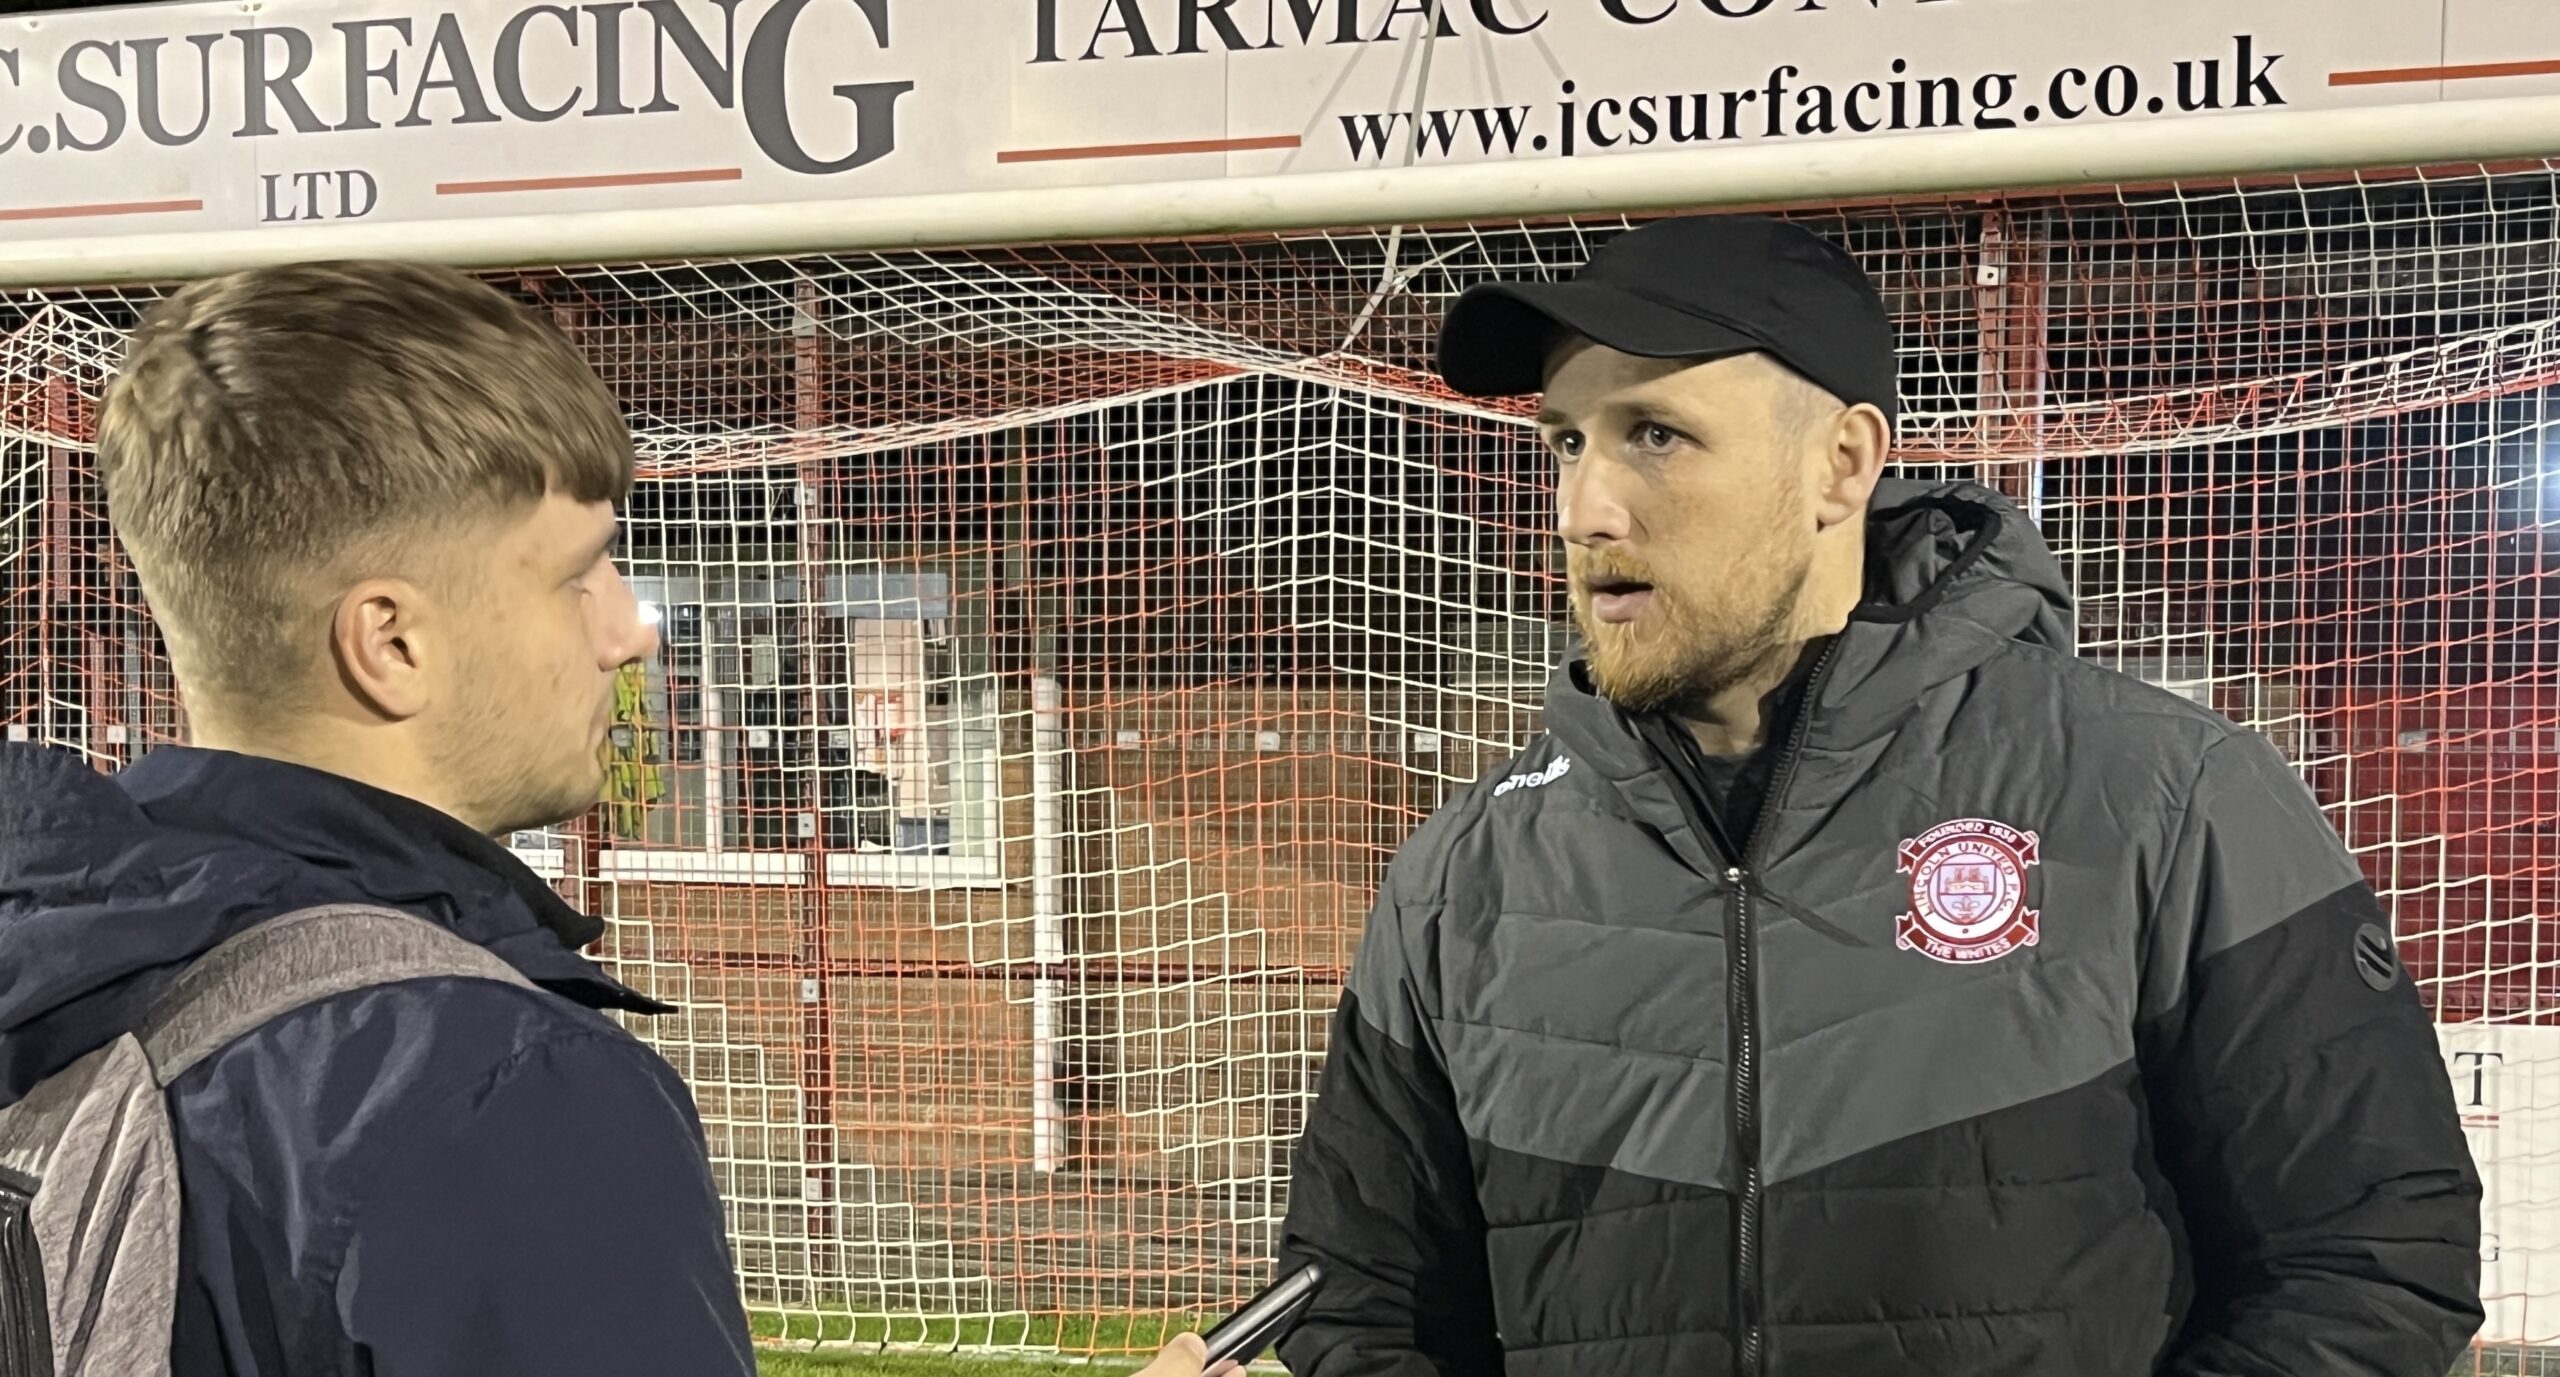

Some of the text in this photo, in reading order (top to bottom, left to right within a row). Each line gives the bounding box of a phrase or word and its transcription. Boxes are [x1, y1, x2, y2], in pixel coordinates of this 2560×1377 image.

[1337, 35, 2287, 161] www.jcsurfacing.co.uk
[260, 169, 379, 223] LTD
[1957, 842, 2015, 875] UNITED
[1925, 938, 2011, 959] THE WHITES
